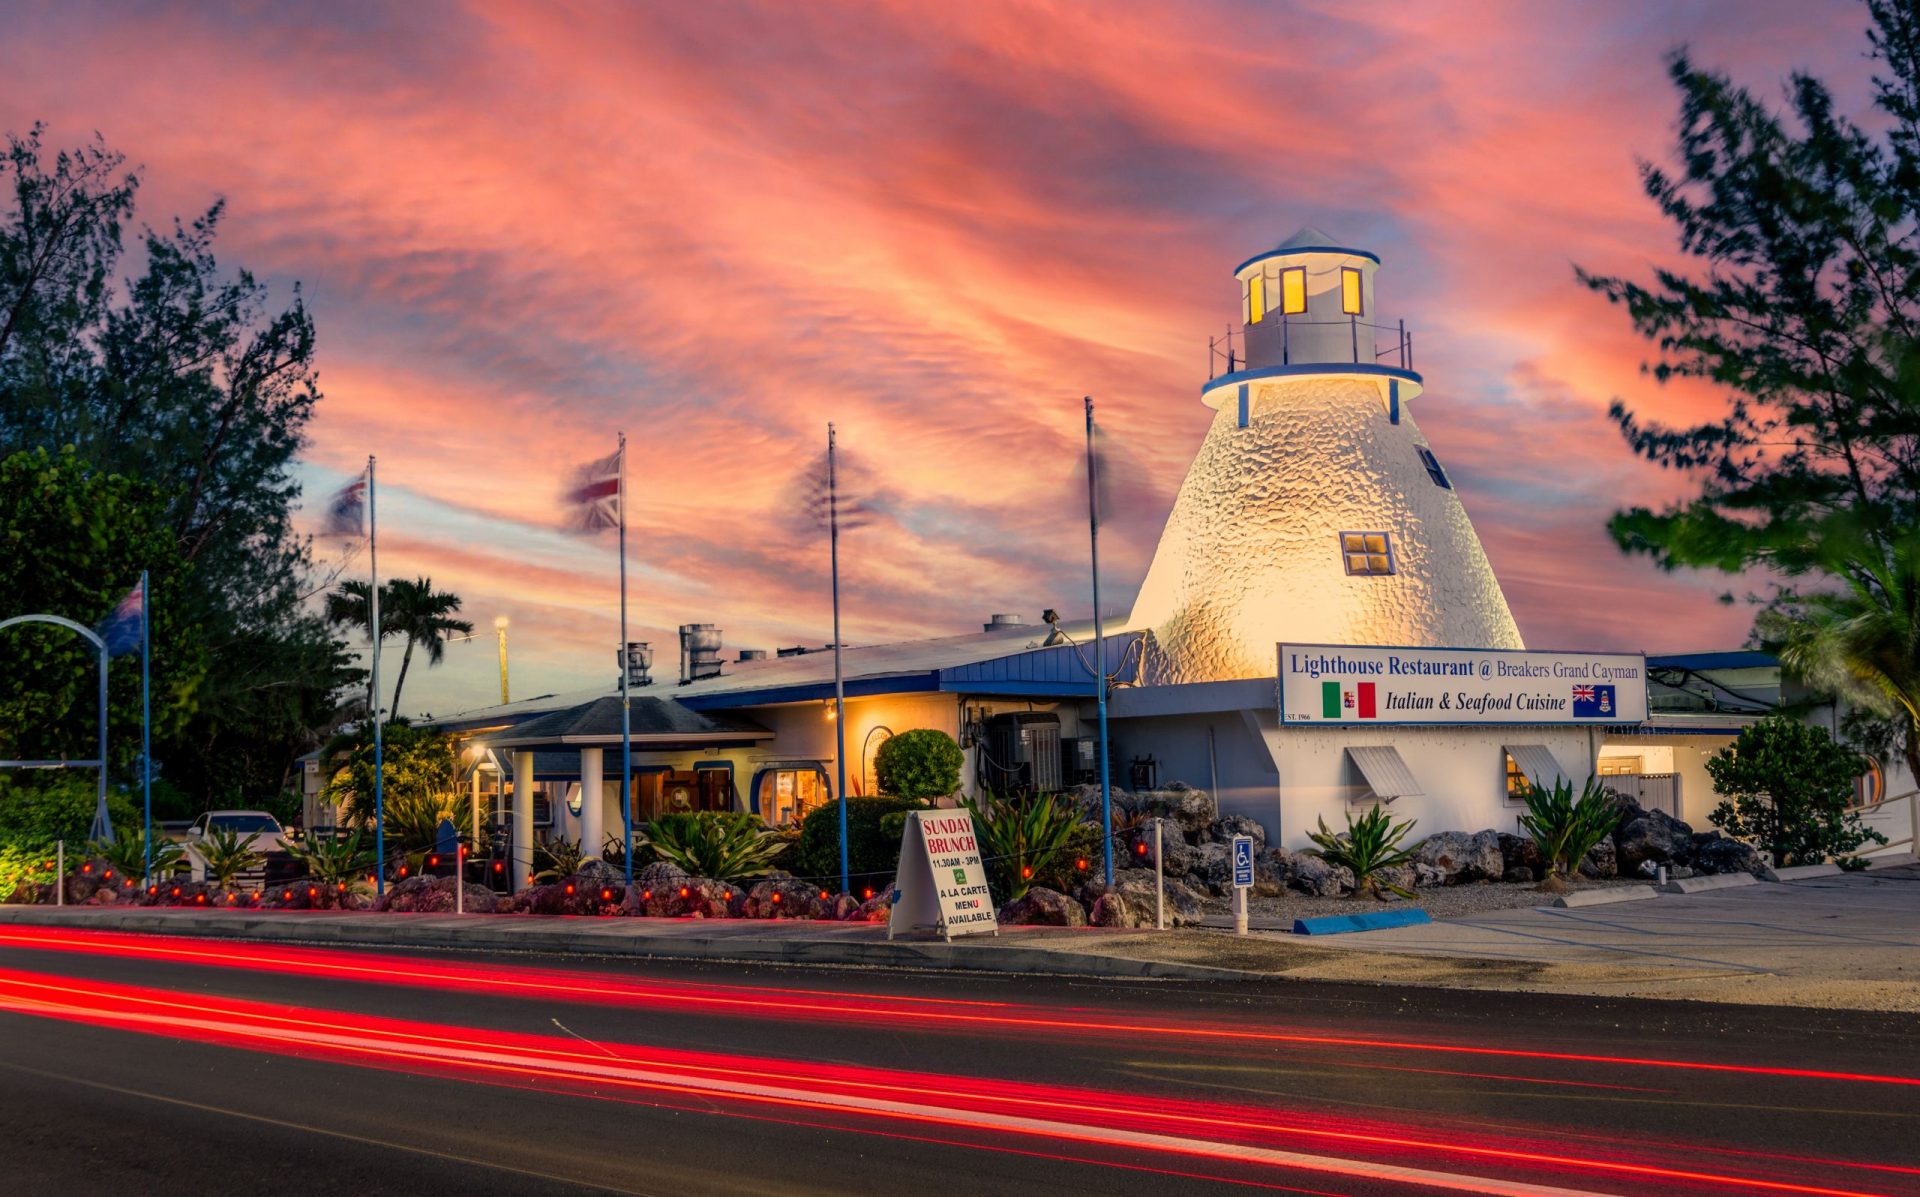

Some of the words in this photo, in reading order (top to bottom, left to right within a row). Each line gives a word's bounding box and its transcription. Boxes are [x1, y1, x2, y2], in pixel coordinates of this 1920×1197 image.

[1291, 654, 1383, 678] Lighthouse
[1388, 656, 1473, 676] Restaurant
[1479, 660, 1492, 681] @
[1497, 660, 1550, 678] Breakers
[1553, 661, 1589, 679] Grand
[1592, 662, 1639, 683] Cayman
[1385, 692, 1433, 710] Italian
[1439, 691, 1451, 710] &
[1455, 692, 1512, 714] Seafood
[1516, 692, 1566, 711] Cuisine
[1298, 713, 1311, 721] 1966
[923, 818, 971, 836] SUNDAY
[927, 836, 976, 854] BRUNCH
[966, 856, 980, 866] 3PM
[940, 889, 947, 898] A
[948, 888, 959, 897] LA
[961, 885, 988, 896] CARTE
[955, 899, 979, 910] MENU
[948, 911, 992, 925] AVAILABLE
